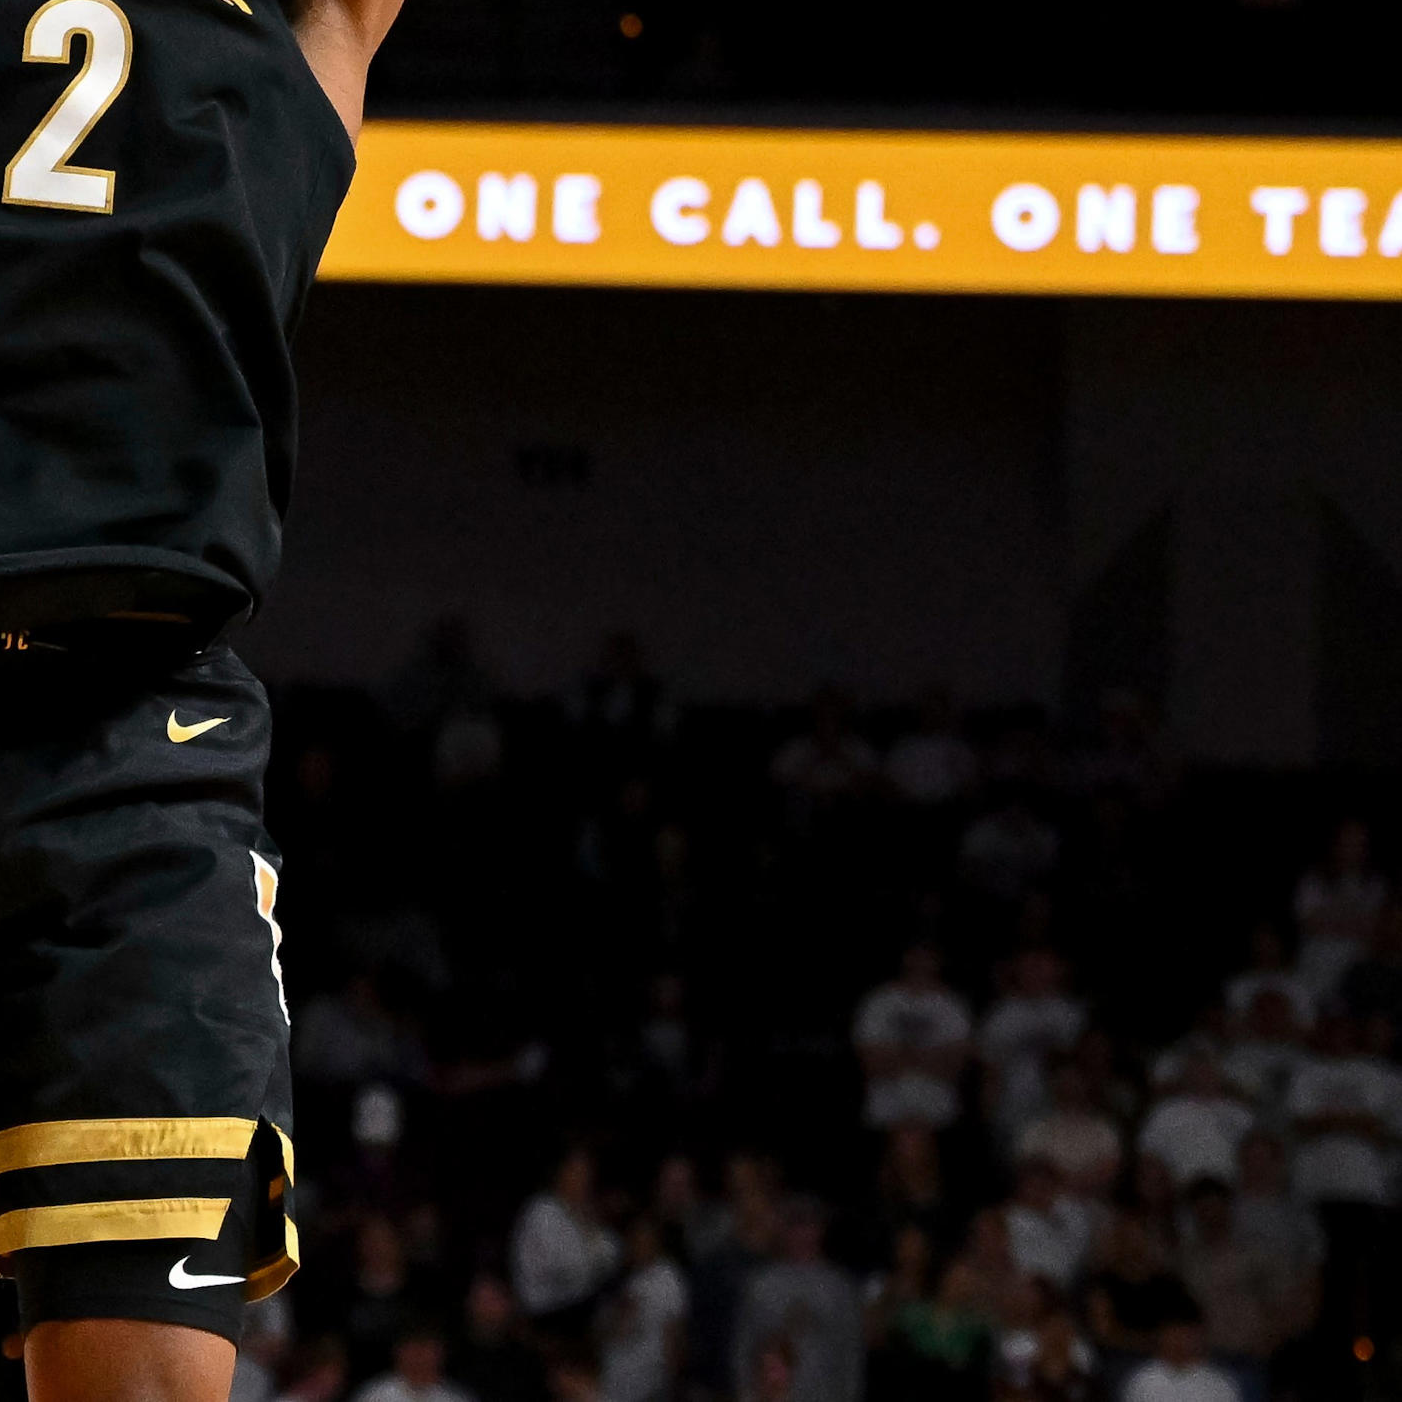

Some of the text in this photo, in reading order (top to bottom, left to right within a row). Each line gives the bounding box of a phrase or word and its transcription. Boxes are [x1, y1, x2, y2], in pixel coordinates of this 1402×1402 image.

[395, 169, 602, 244] ONE
[649, 175, 941, 251] CALL.
[990, 181, 1201, 255] ONE
